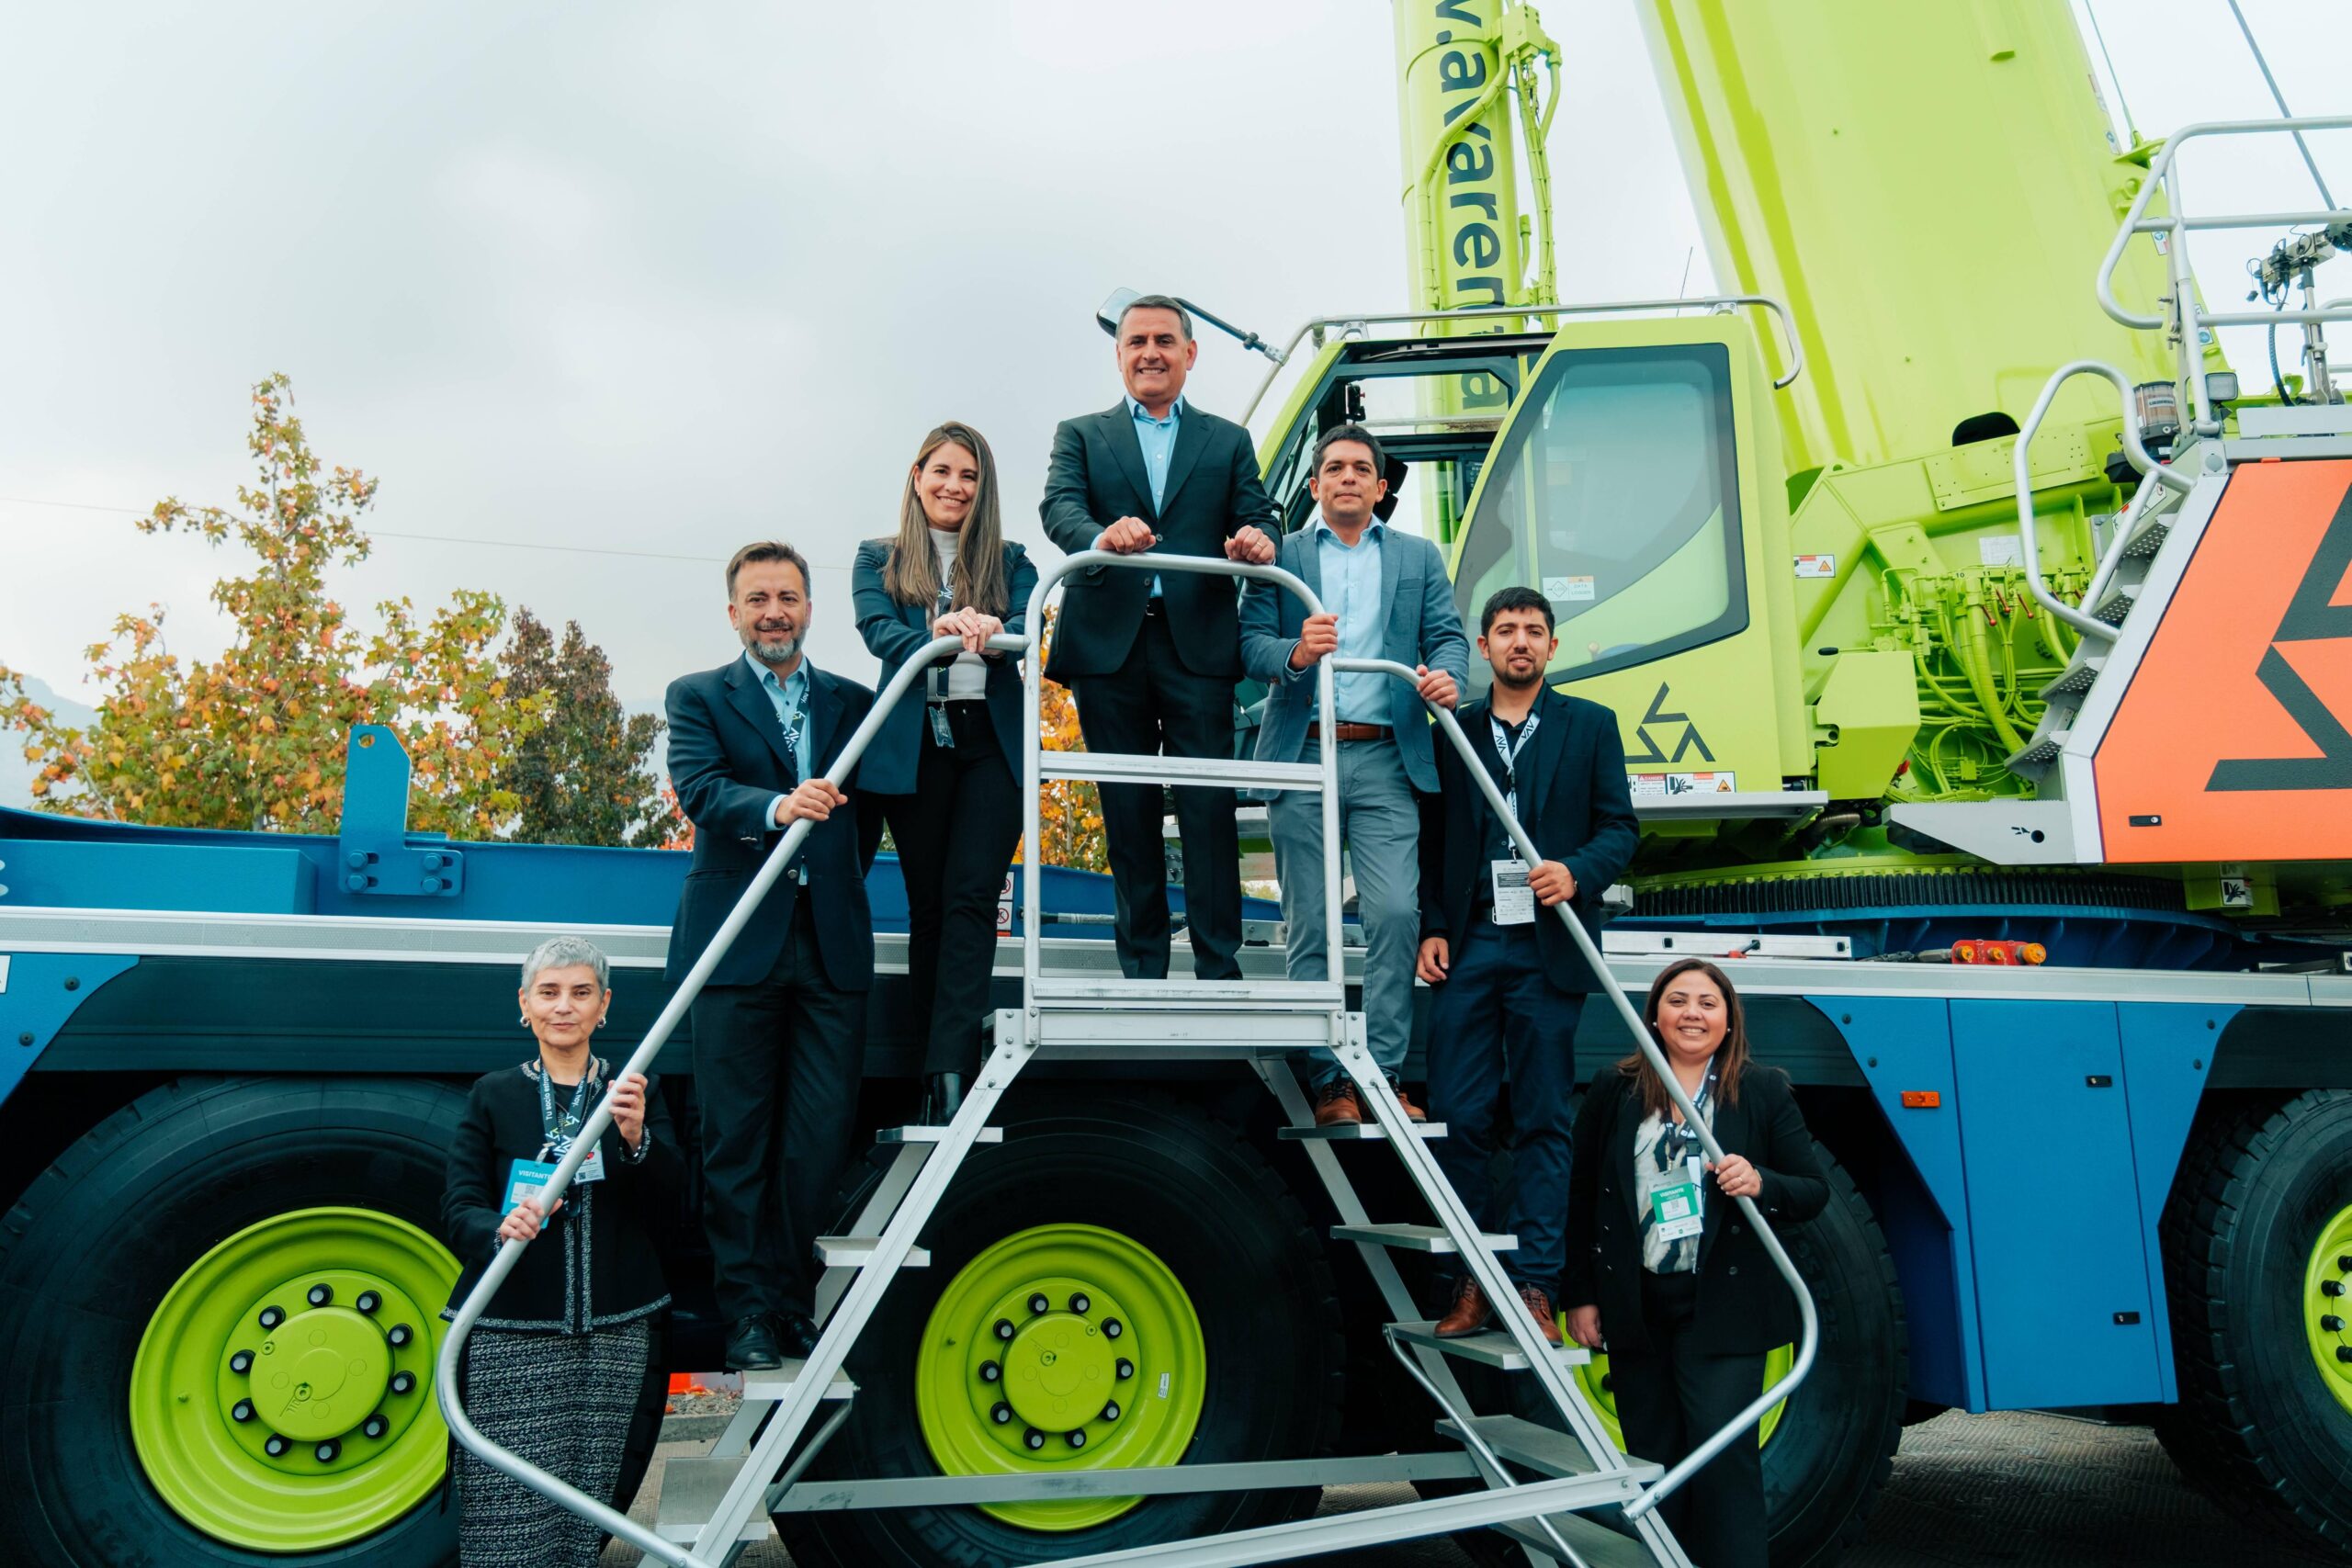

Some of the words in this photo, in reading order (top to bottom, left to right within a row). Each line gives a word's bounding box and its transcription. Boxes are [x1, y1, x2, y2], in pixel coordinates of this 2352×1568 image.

[544, 1093, 552, 1111] socio
[545, 1111, 553, 1121] Tu
[517, 1169, 551, 1179] VISITANT
